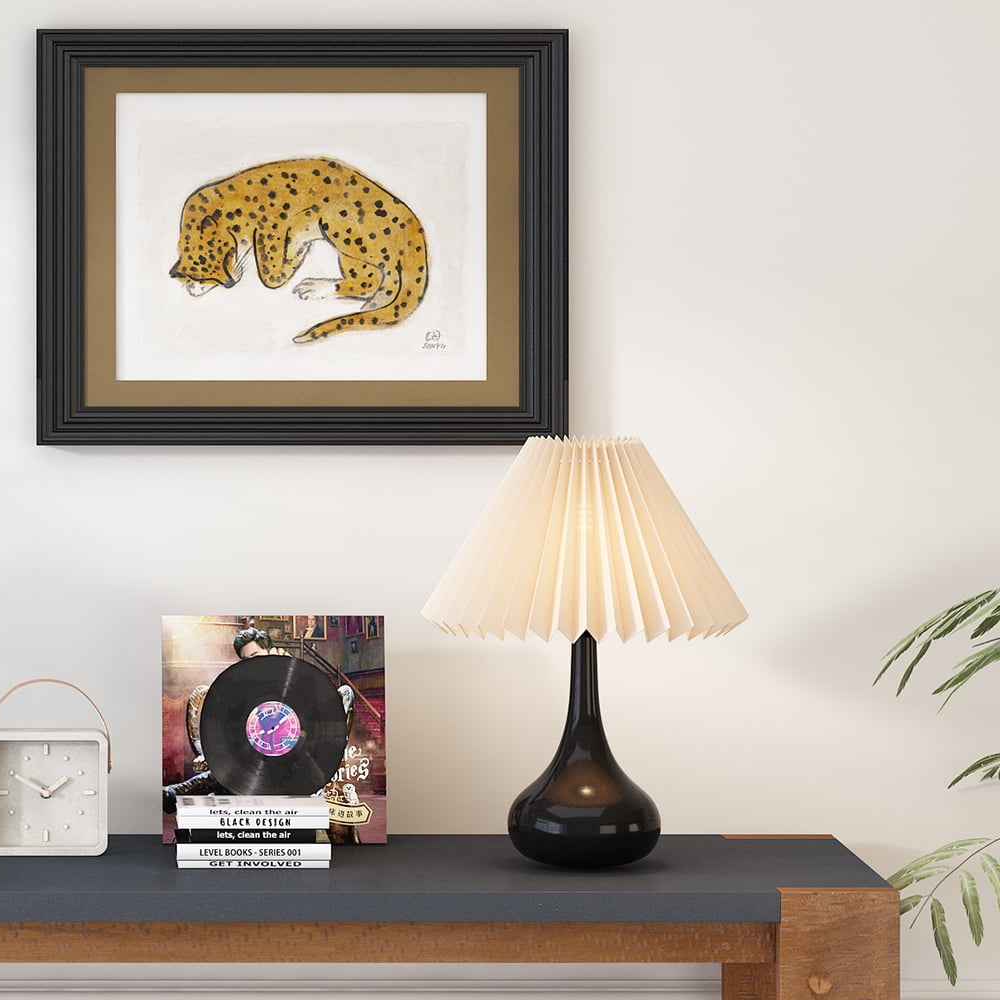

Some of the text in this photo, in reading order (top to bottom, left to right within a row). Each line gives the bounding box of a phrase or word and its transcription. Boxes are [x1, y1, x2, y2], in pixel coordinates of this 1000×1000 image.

[219, 818, 291, 827] BLACK DESIGN
[216, 830, 291, 839] lets, clean the air
[199, 848, 223, 857] LEVEL
[225, 848, 252, 857] BOOKS
[258, 848, 286, 857] SERIES
[287, 848, 301, 857] 001
